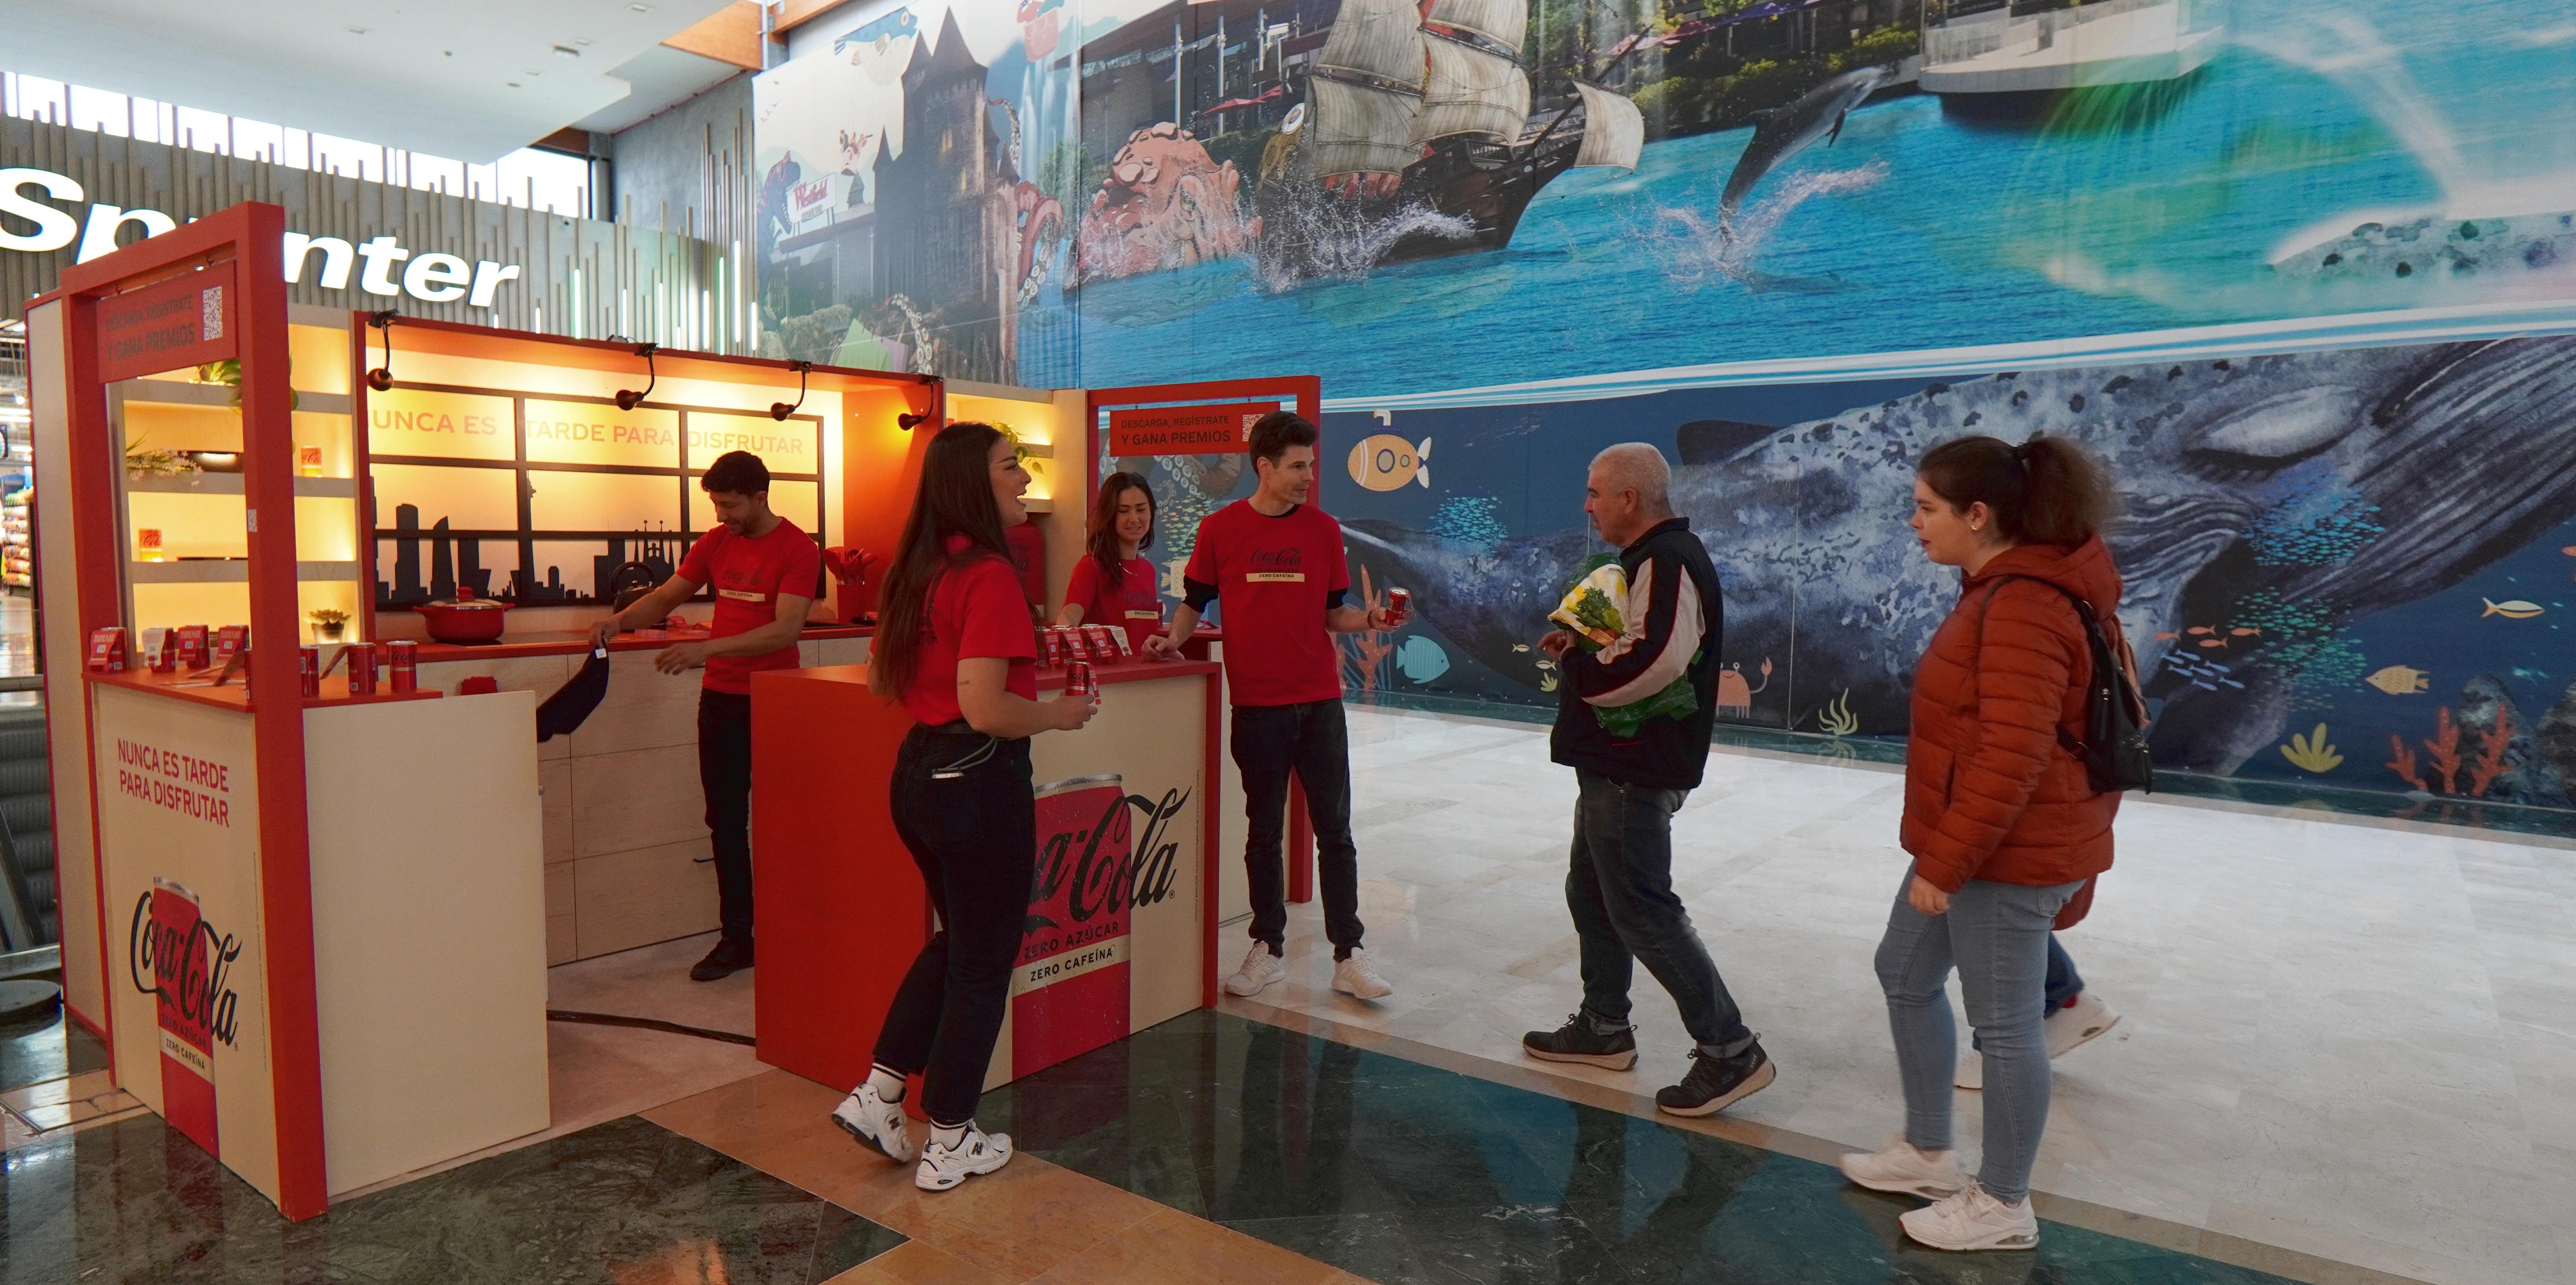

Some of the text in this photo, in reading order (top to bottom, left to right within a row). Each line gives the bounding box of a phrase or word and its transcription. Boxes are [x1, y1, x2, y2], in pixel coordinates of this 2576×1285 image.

[0, 168, 520, 307] Spnter
[107, 322, 196, 362] Y GANA PREMIOS
[373, 409, 803, 455] UNCA ES TARDE PARA DISFRUTAR
[1121, 415, 1230, 428] DESCARGA, REGÍSTRATE
[1121, 430, 1231, 446] Y GANA PREMIOS
[117, 737, 229, 793] NUNCA ES TARDE
[119, 769, 230, 828] PARA DISFRUTAR
[1028, 786, 1192, 923] a-Cola
[1025, 921, 1119, 960] ZERO AZÚCAR
[130, 890, 242, 1046] Coca-Cola
[1030, 948, 1112, 982] ZERO CAFEÍNA
[162, 1013, 207, 1047] ZERO AZÚCAR
[166, 1037, 205, 1071] ZERO CAFEÍNA
[971, 1142, 984, 1155] N
